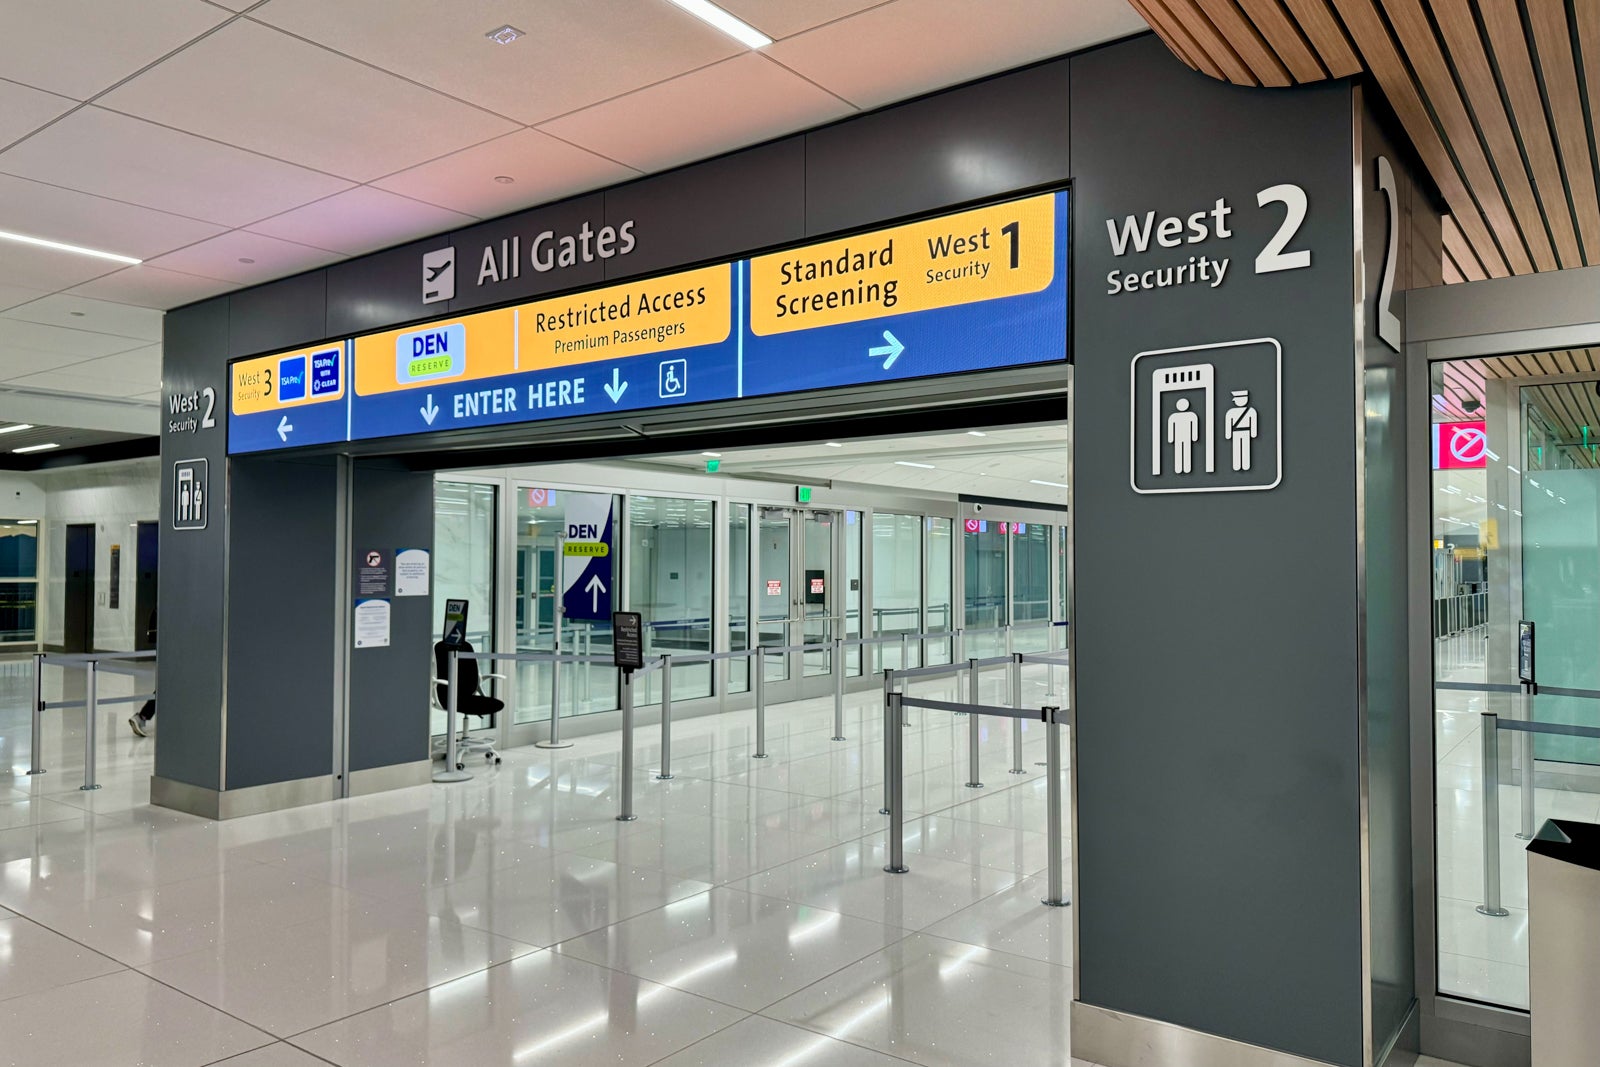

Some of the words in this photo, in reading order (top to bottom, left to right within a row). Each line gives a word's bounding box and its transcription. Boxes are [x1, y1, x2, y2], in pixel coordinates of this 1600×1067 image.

[1106, 198, 1233, 257] West
[1255, 184, 1312, 274] 2
[477, 236, 520, 286] All
[530, 220, 636, 273] Gates
[927, 226, 990, 260] West
[1000, 221, 1020, 269] 1
[780, 239, 894, 285] Standard
[926, 259, 991, 284] Security
[1106, 256, 1230, 295] Security
[535, 295, 630, 333] Restricted
[637, 286, 706, 316] Access
[776, 276, 898, 318] Screening
[412, 331, 448, 357] DEN
[554, 333, 609, 354] Premium
[613, 321, 685, 347] Passengers
[238, 370, 260, 387] West
[411, 359, 450, 373] RESERVE
[238, 390, 260, 401] Security
[264, 369, 272, 396] 3
[281, 377, 290, 386] TSA
[321, 379, 337, 388] CLEAR
[169, 392, 198, 414] West
[202, 387, 216, 428] 2
[453, 387, 517, 418] ENTER
[528, 378, 585, 409] HERE
[169, 418, 197, 433] Security
[568, 524, 598, 539] DEN
[567, 545, 606, 554] RESERVE
